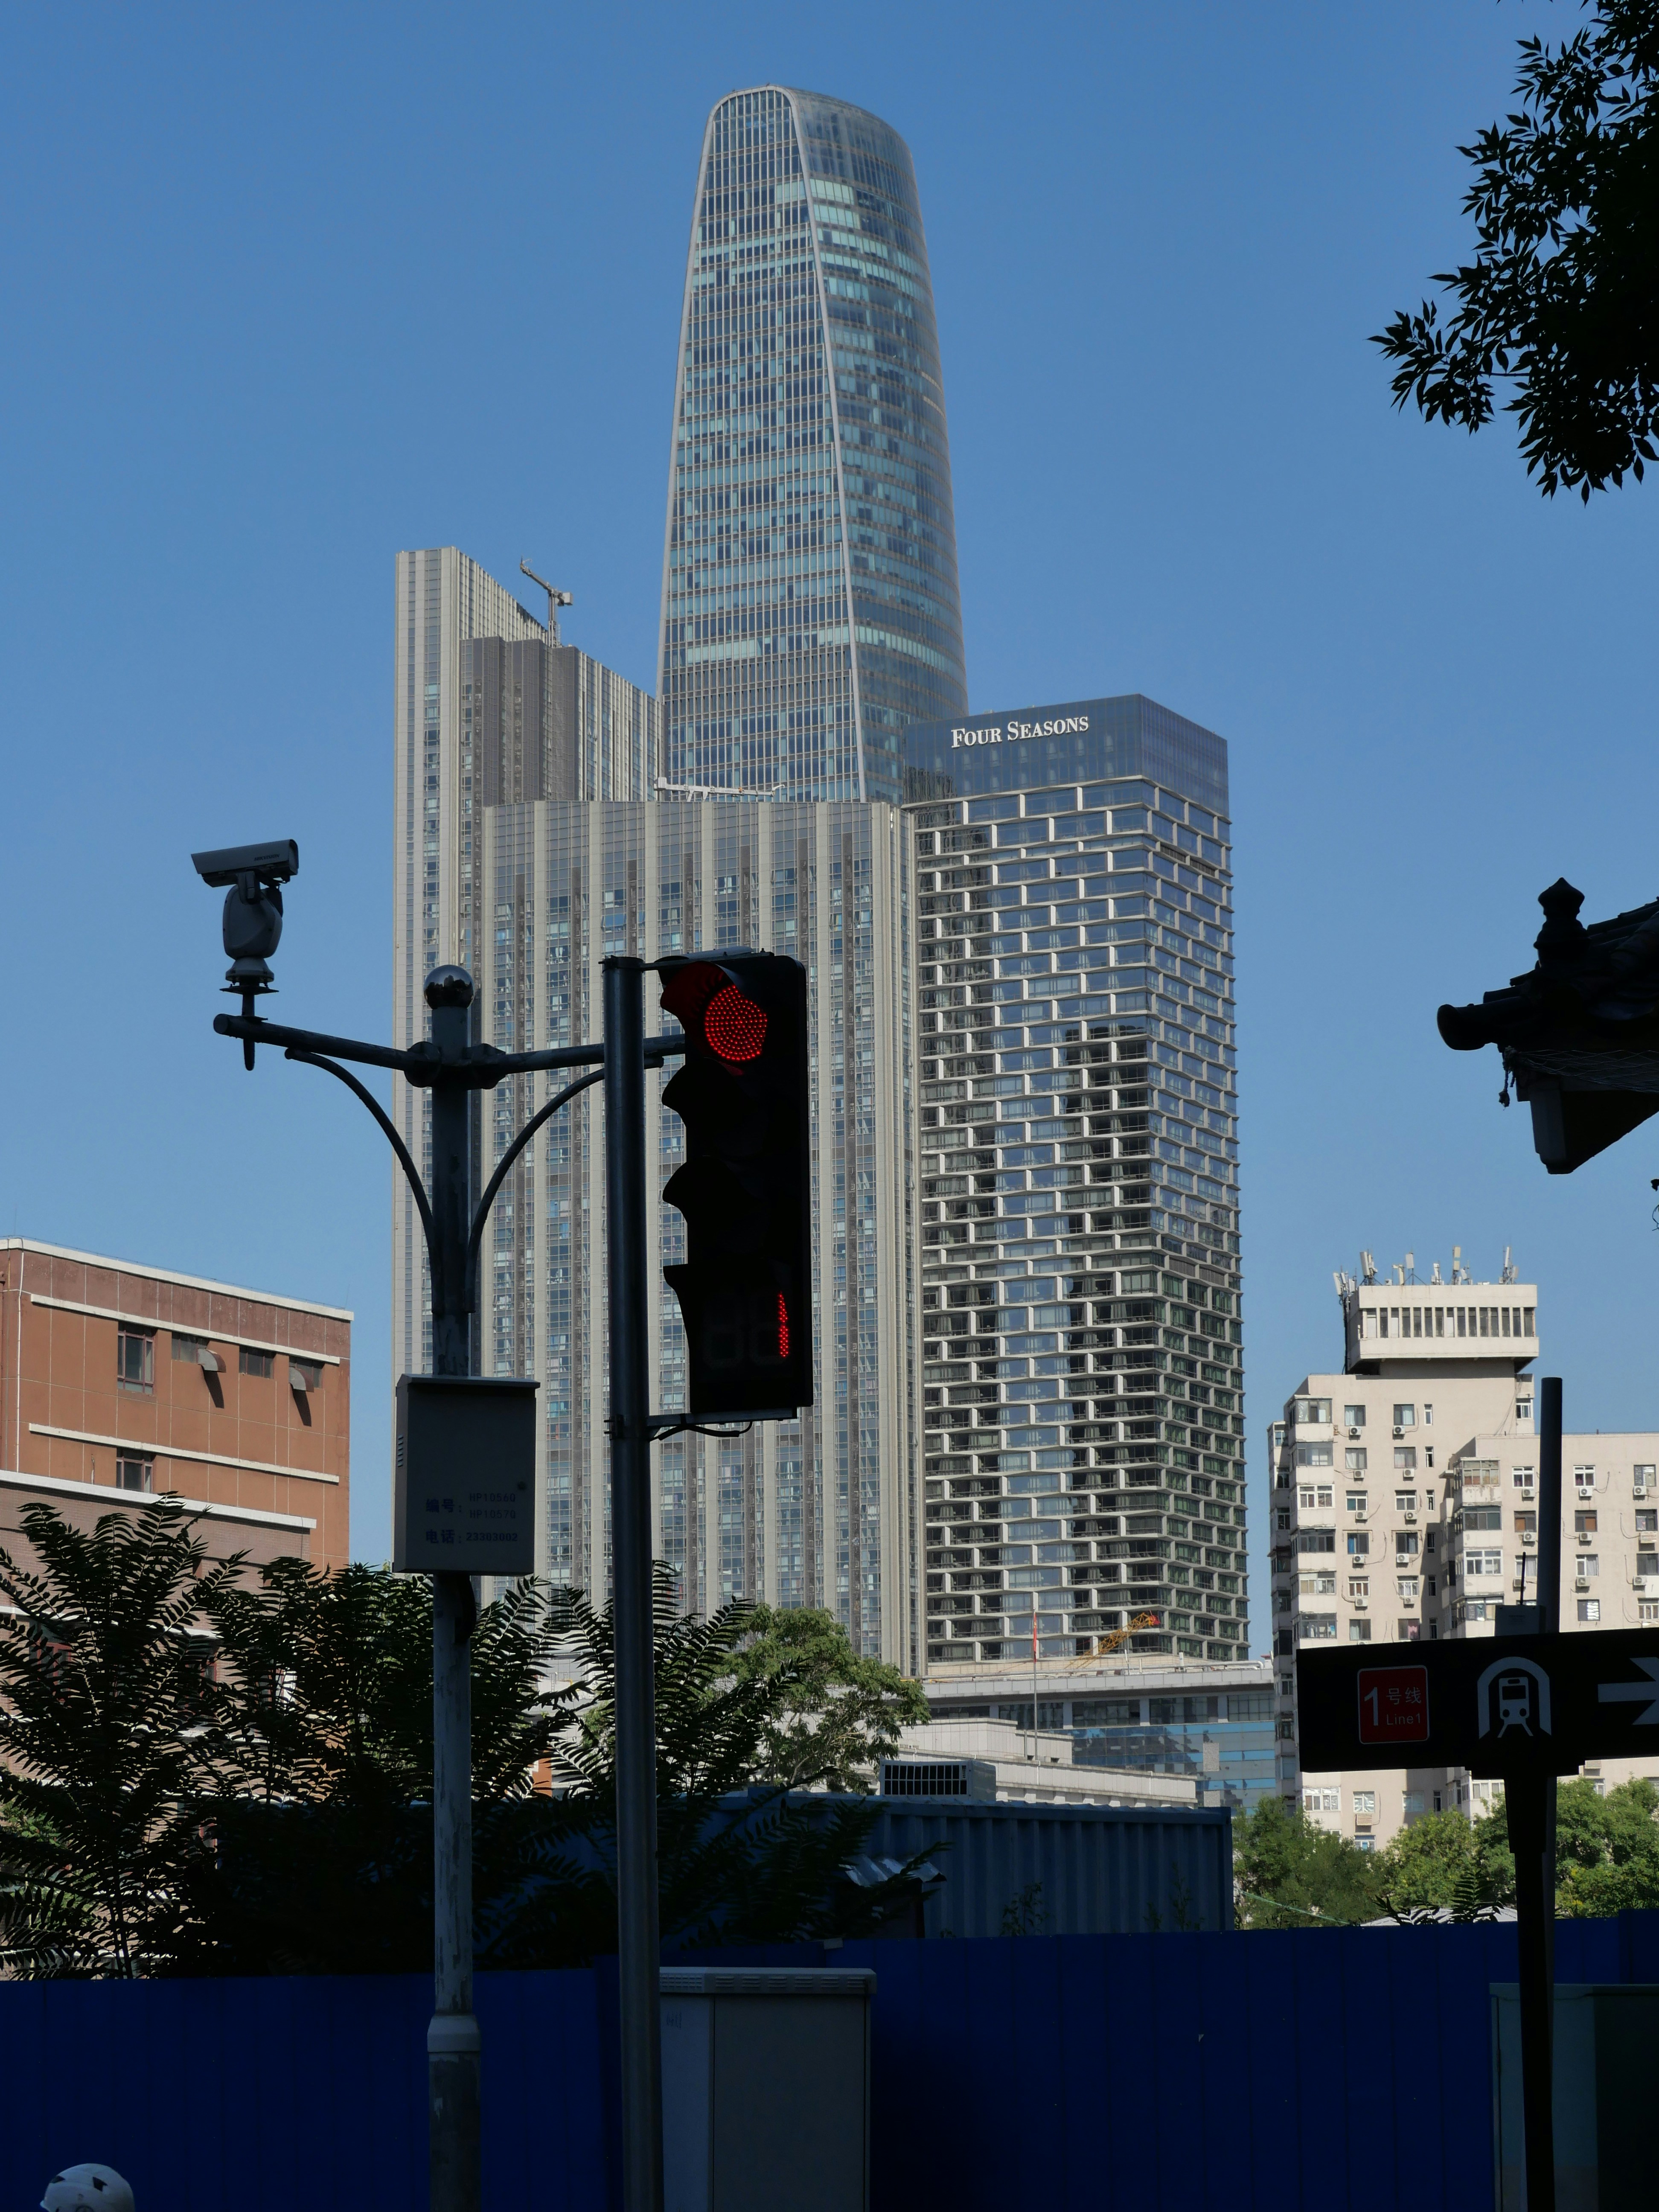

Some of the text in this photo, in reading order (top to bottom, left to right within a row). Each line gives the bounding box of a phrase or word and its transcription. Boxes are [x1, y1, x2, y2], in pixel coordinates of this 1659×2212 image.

[951, 716, 1089, 748] FOUR SEASONS
[254, 853, 280, 861] HIKVISION
[466, 1532, 518, 1542] 23303002
[1364, 1686, 1422, 1727] 1 号线
